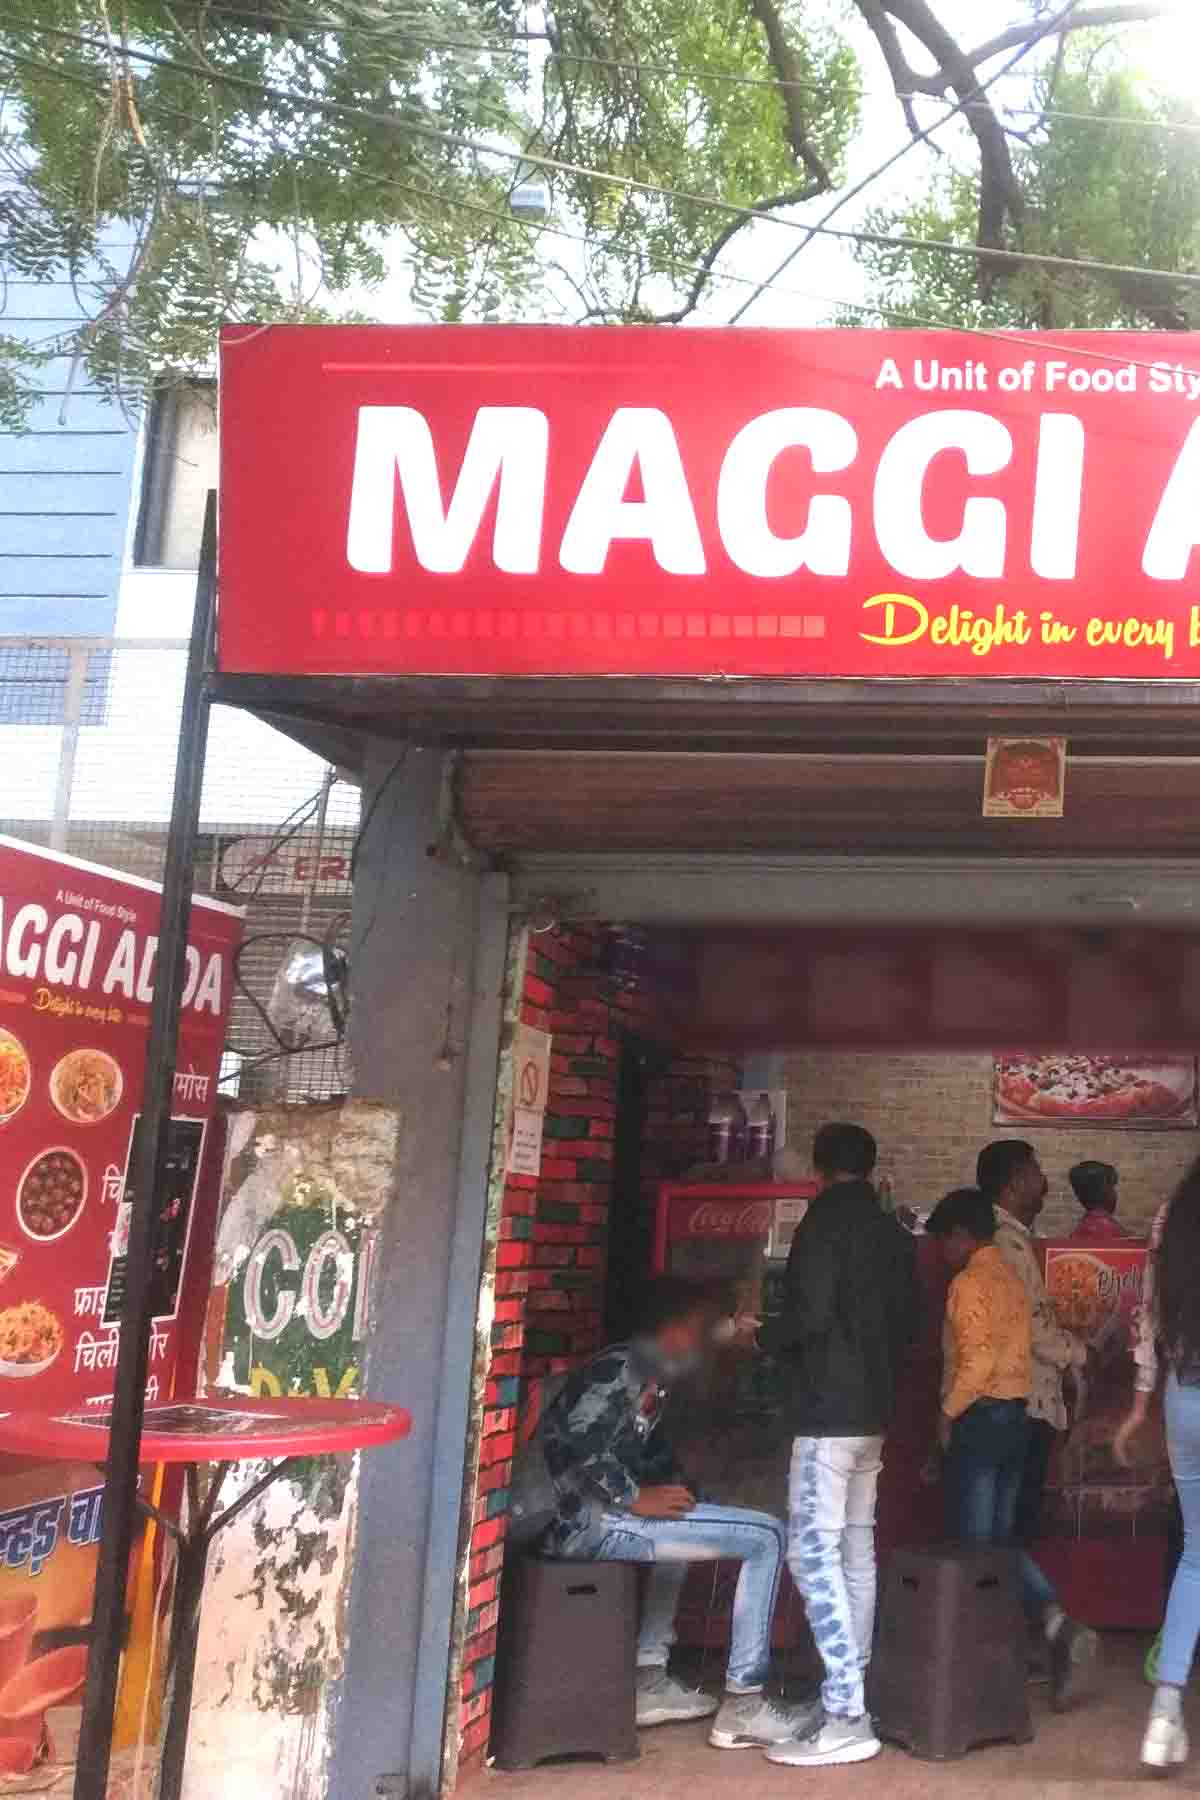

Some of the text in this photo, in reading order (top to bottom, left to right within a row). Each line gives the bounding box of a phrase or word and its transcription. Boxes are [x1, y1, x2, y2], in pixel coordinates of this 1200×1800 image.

[876, 360, 903, 389] A
[913, 360, 988, 391] Unit
[998, 360, 1036, 391] of
[1046, 362, 1137, 392] Food
[346, 404, 1085, 581] MAGGI
[858, 593, 1032, 656] Delight
[1039, 611, 1077, 643] in
[1086, 617, 1175, 659] every
[0, 896, 101, 989] GGI
